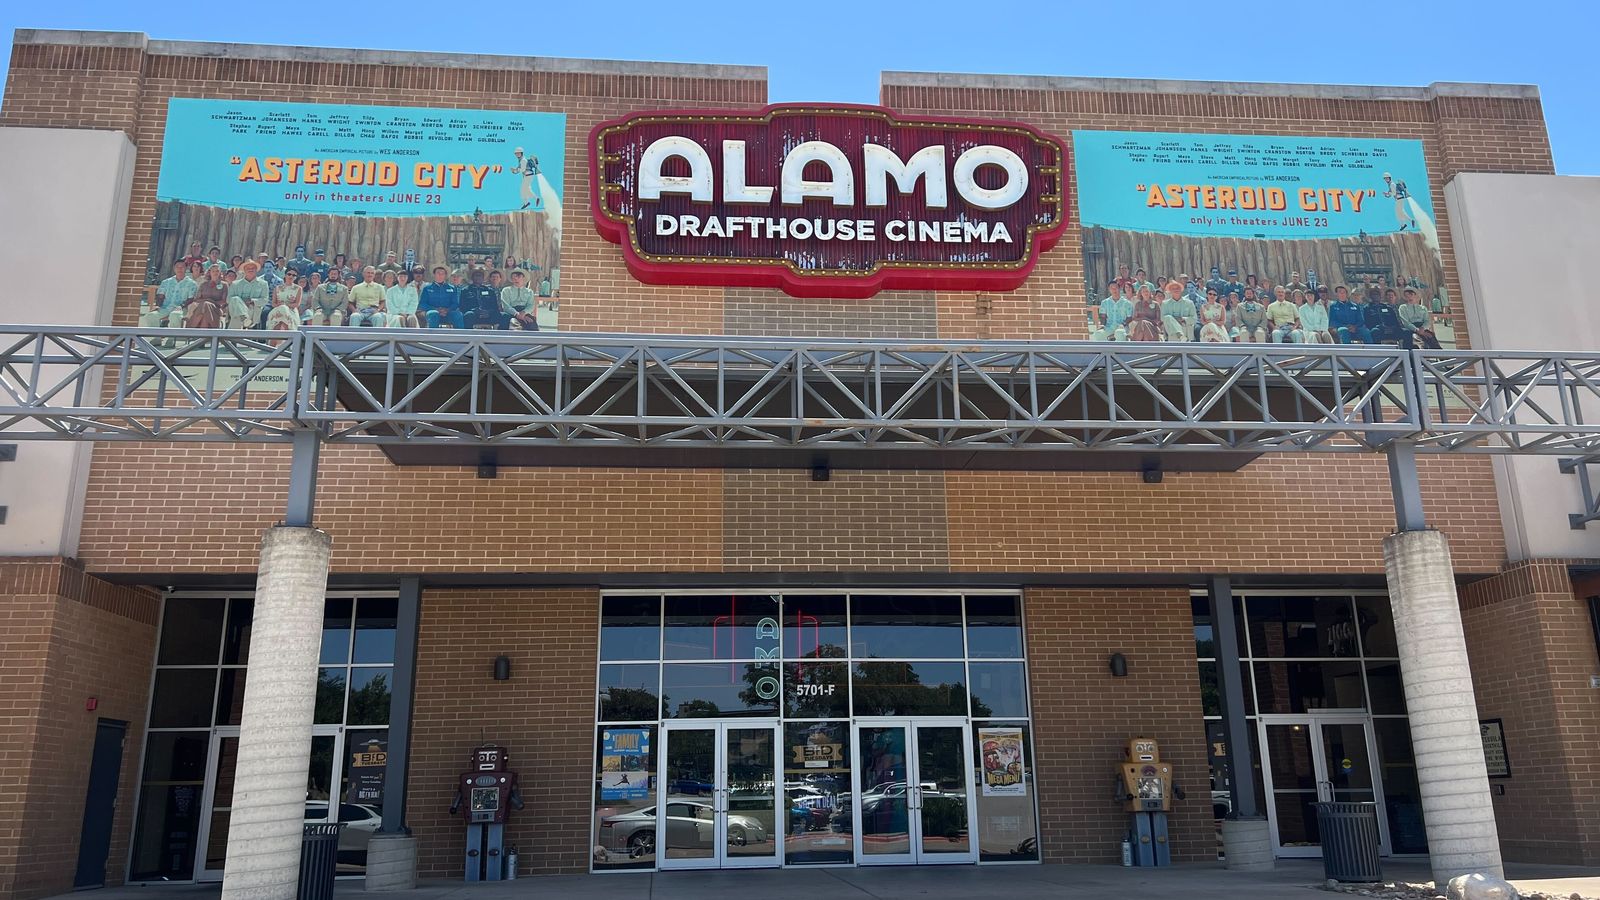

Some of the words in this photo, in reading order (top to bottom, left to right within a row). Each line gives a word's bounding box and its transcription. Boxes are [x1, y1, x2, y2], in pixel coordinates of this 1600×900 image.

[638, 134, 1030, 211] ALAMO
[285, 191, 309, 205] only
[314, 192, 325, 203] in
[330, 193, 384, 204] theaters
[389, 194, 421, 204] JUNE
[426, 195, 441, 205] 23
[1191, 216, 1213, 227] only
[1217, 216, 1226, 225] in
[1231, 216, 1277, 226] theaters
[1282, 217, 1310, 226] JUNE
[1314, 218, 1328, 227] 23
[655, 214, 876, 242] DRAFTHOUSE
[884, 219, 1013, 244] CINEMA
[796, 685, 835, 696] 5701-F
[987, 772, 1004, 785] MEGA
[1005, 772, 1020, 784] MENU
